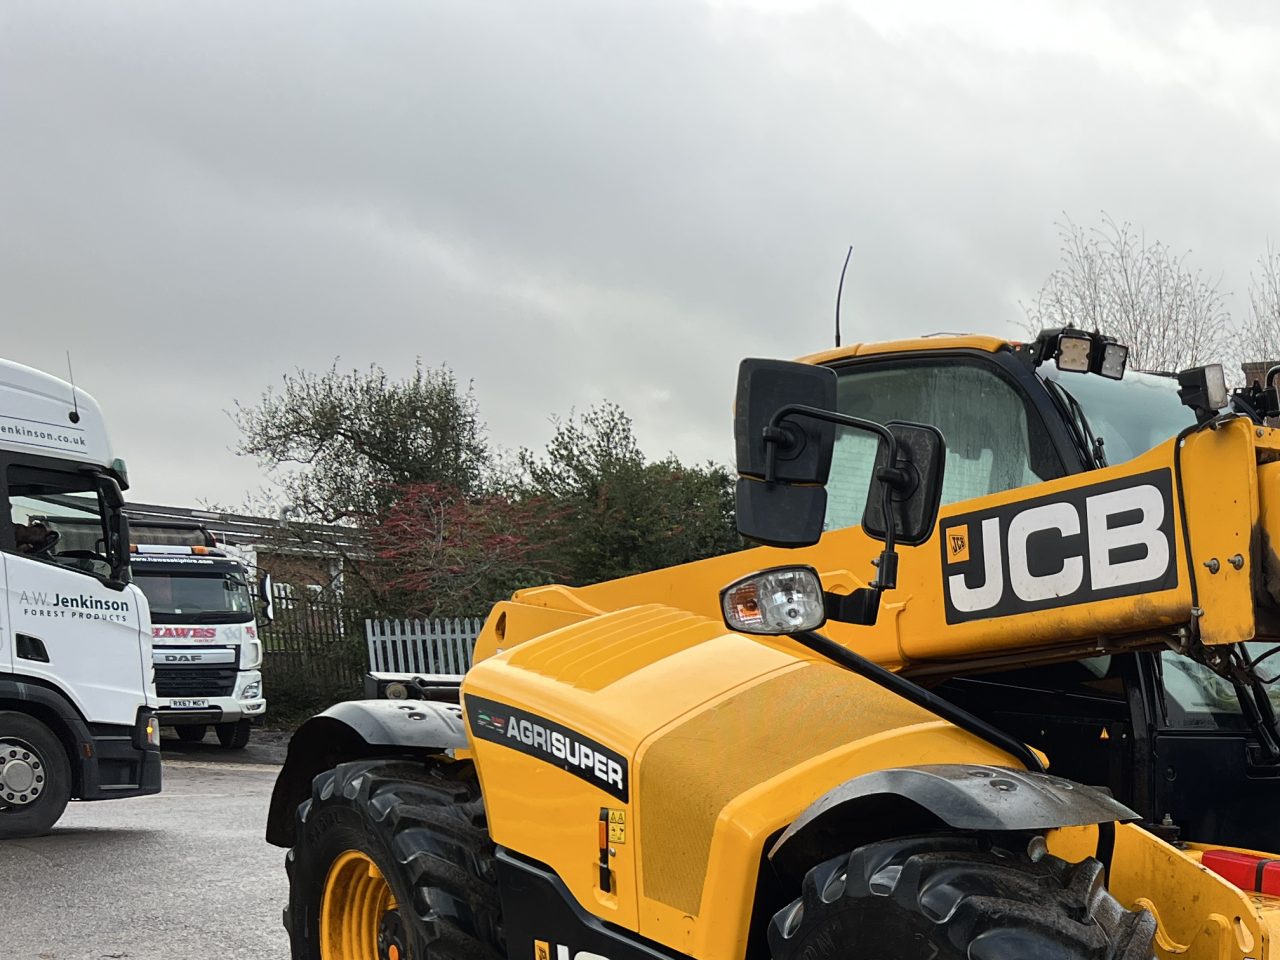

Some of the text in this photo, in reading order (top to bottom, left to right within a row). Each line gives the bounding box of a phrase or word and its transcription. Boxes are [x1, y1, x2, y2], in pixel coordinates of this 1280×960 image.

[948, 484, 1170, 613] JCB
[23, 608, 127, 622] FOREST PRODUCTS
[53, 593, 129, 612] Jenkinson
[506, 715, 624, 790] AGRISUPER
